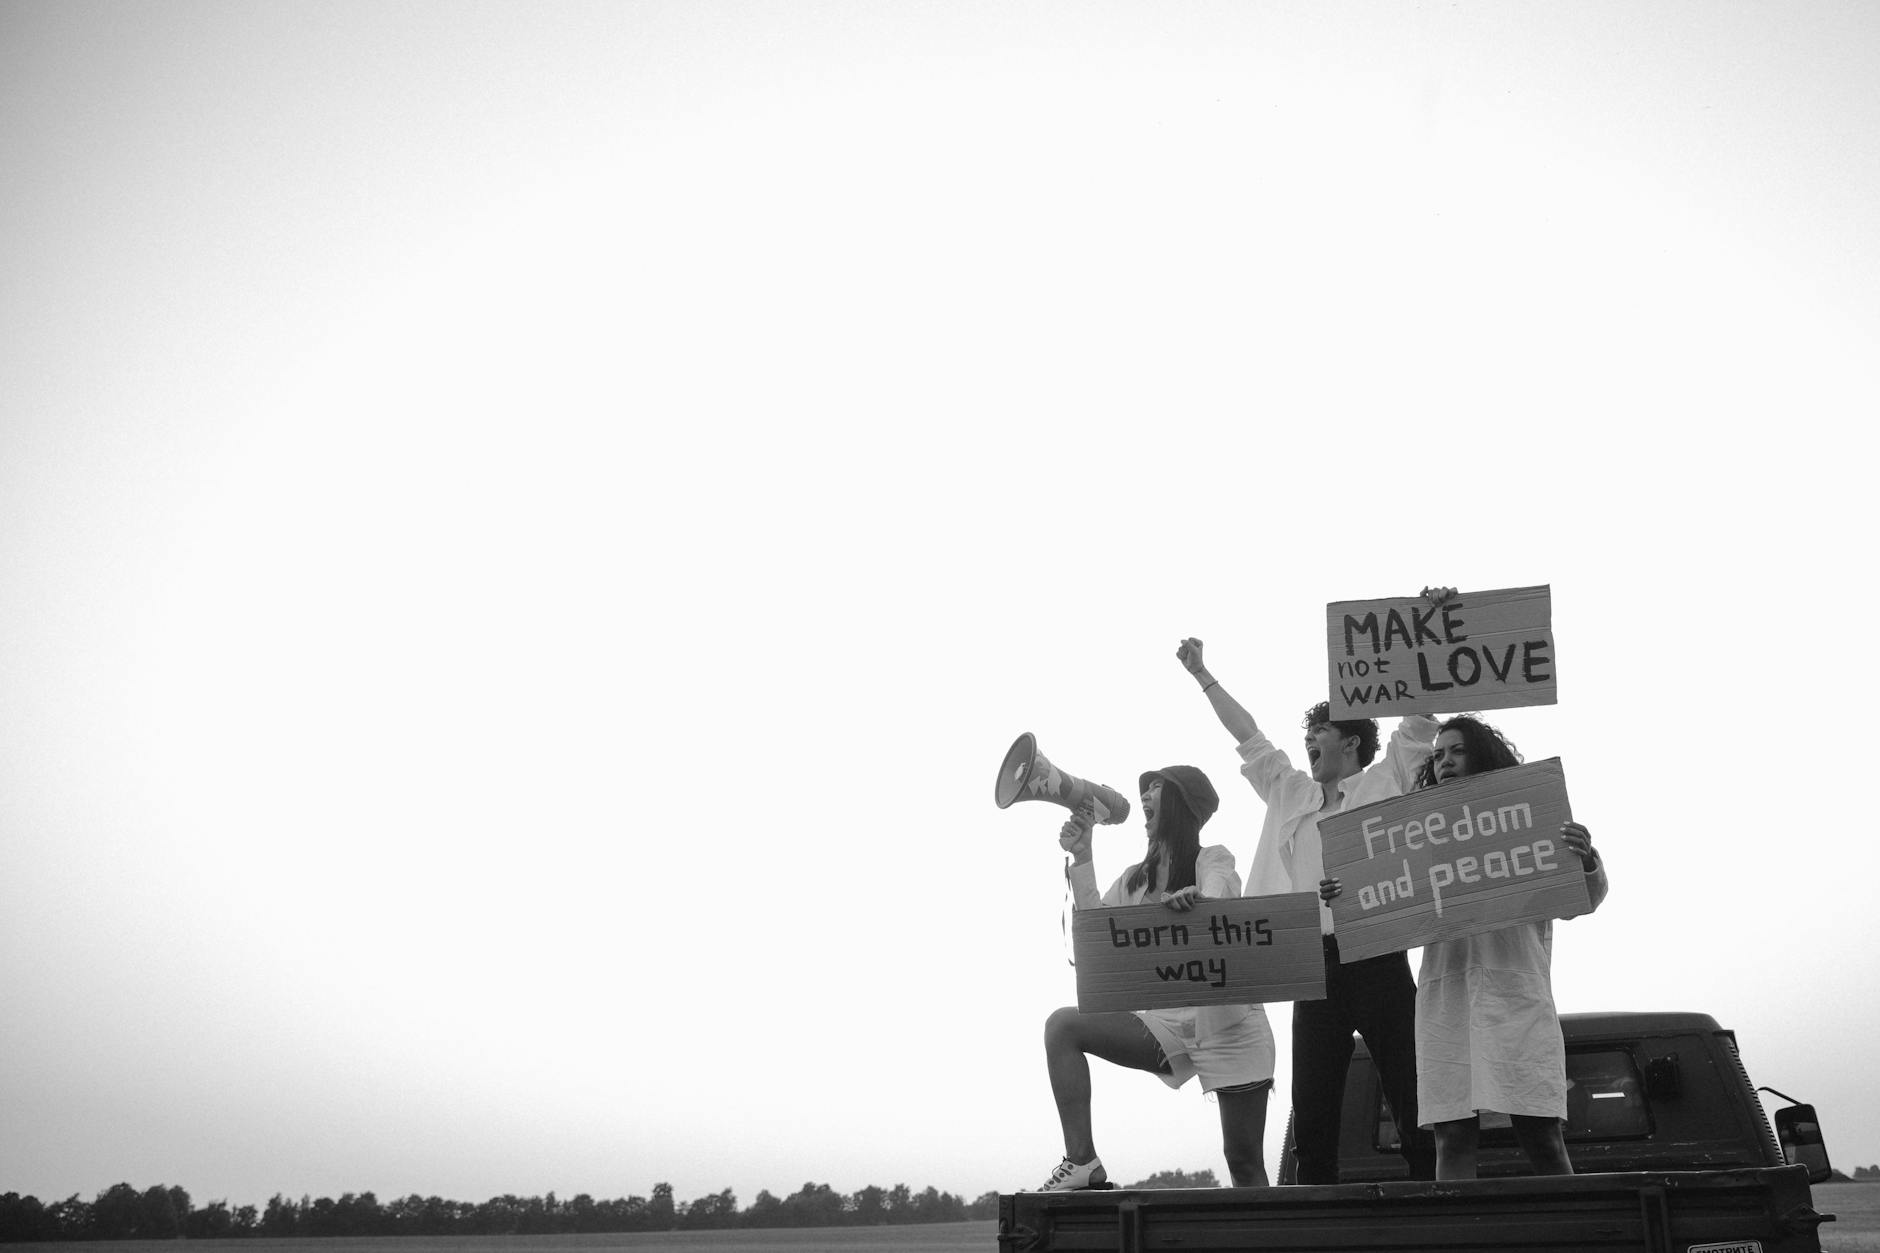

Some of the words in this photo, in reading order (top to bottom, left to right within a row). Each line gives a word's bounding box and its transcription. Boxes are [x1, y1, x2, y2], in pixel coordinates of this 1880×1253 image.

[1344, 603, 1468, 656] MAKE
[1338, 657, 1391, 678] not
[1417, 640, 1550, 690] LOVE
[1340, 680, 1415, 706] WAR
[1361, 803, 1532, 859] Freedom
[1358, 859, 1414, 911] and
[1428, 839, 1558, 918] peace
[1109, 917, 1188, 947] born
[1209, 914, 1272, 946] this
[1155, 958, 1225, 987] way
